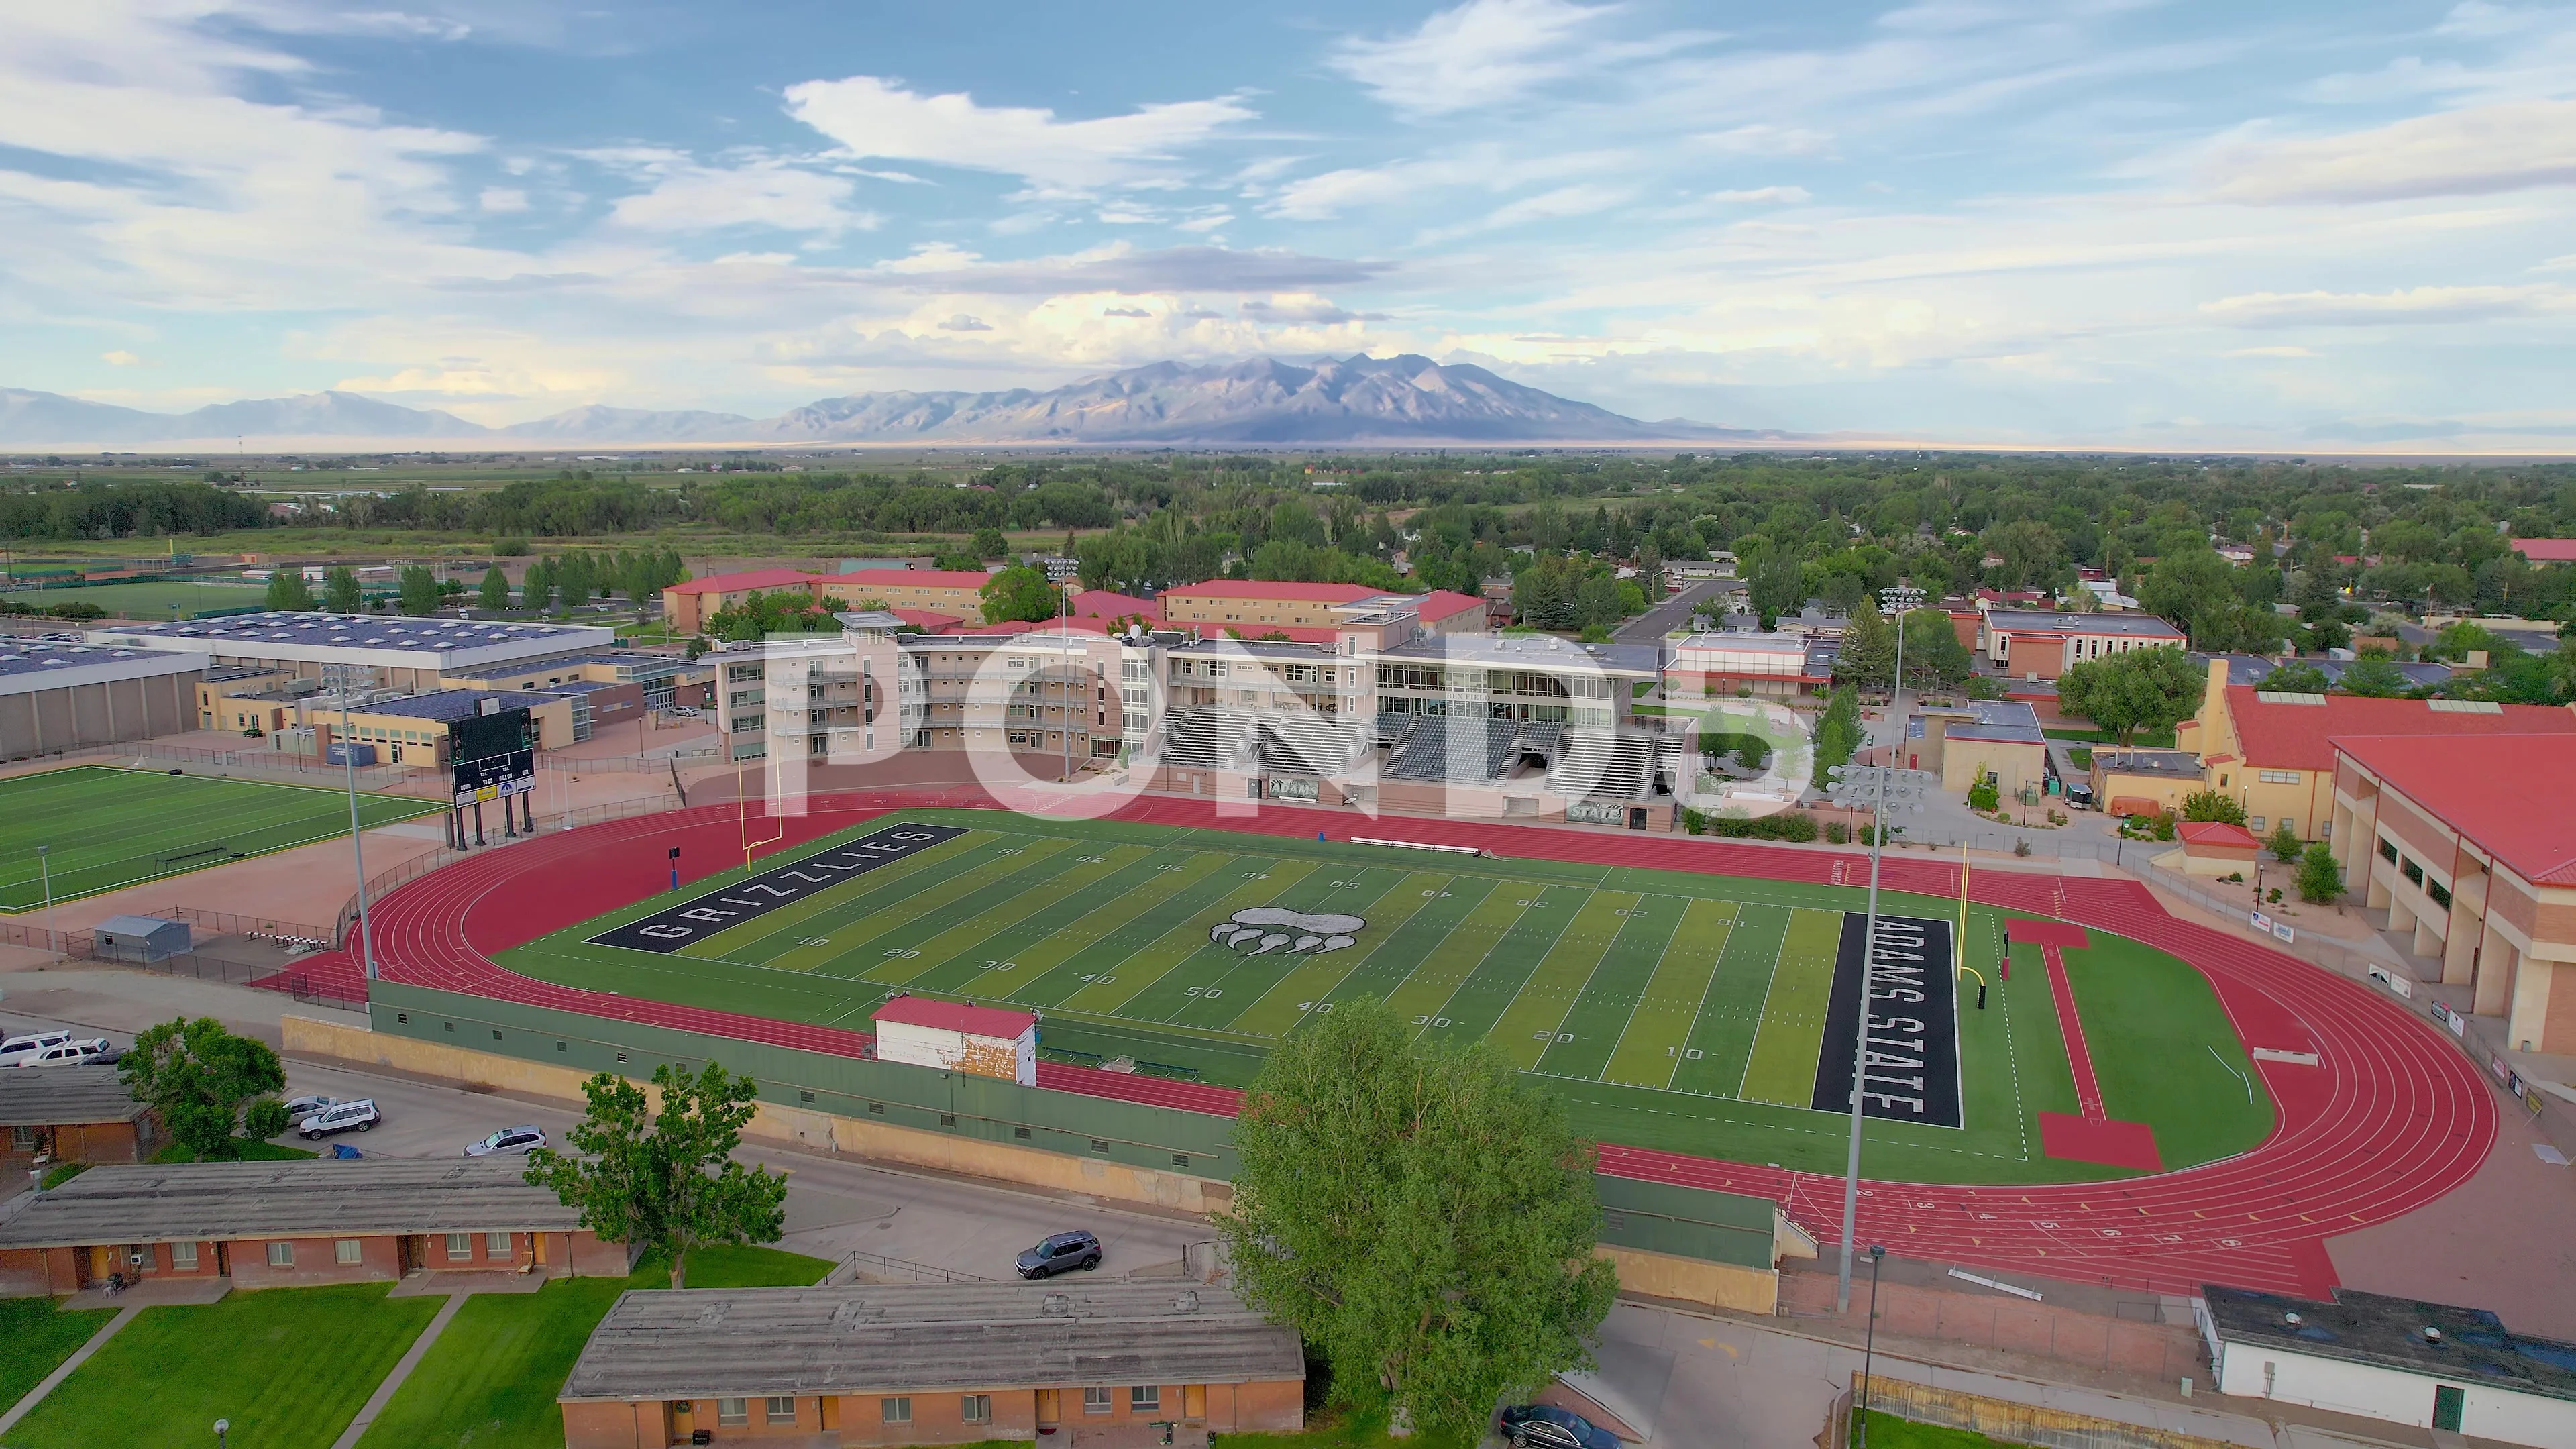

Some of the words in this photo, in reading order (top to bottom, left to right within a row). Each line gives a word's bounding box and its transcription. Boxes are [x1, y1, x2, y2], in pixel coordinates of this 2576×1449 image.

[1271, 783, 1318, 796] ADAMS
[1571, 806, 1621, 819] STATE
[639, 830, 934, 938] GRIZZLIES
[796, 936, 830, 947] 10
[883, 948, 921, 959] 20
[979, 961, 1016, 971] 30
[1869, 920, 1925, 1003] ADAMS
[1080, 973, 1116, 985] 40
[1184, 987, 1223, 998] 50
[1296, 1002, 1334, 1013] 40
[1411, 1016, 1452, 1028] 30
[1532, 1030, 1575, 1043] 20
[1664, 1046, 1703, 1059] 10
[1849, 1013, 1925, 1113] STATE
